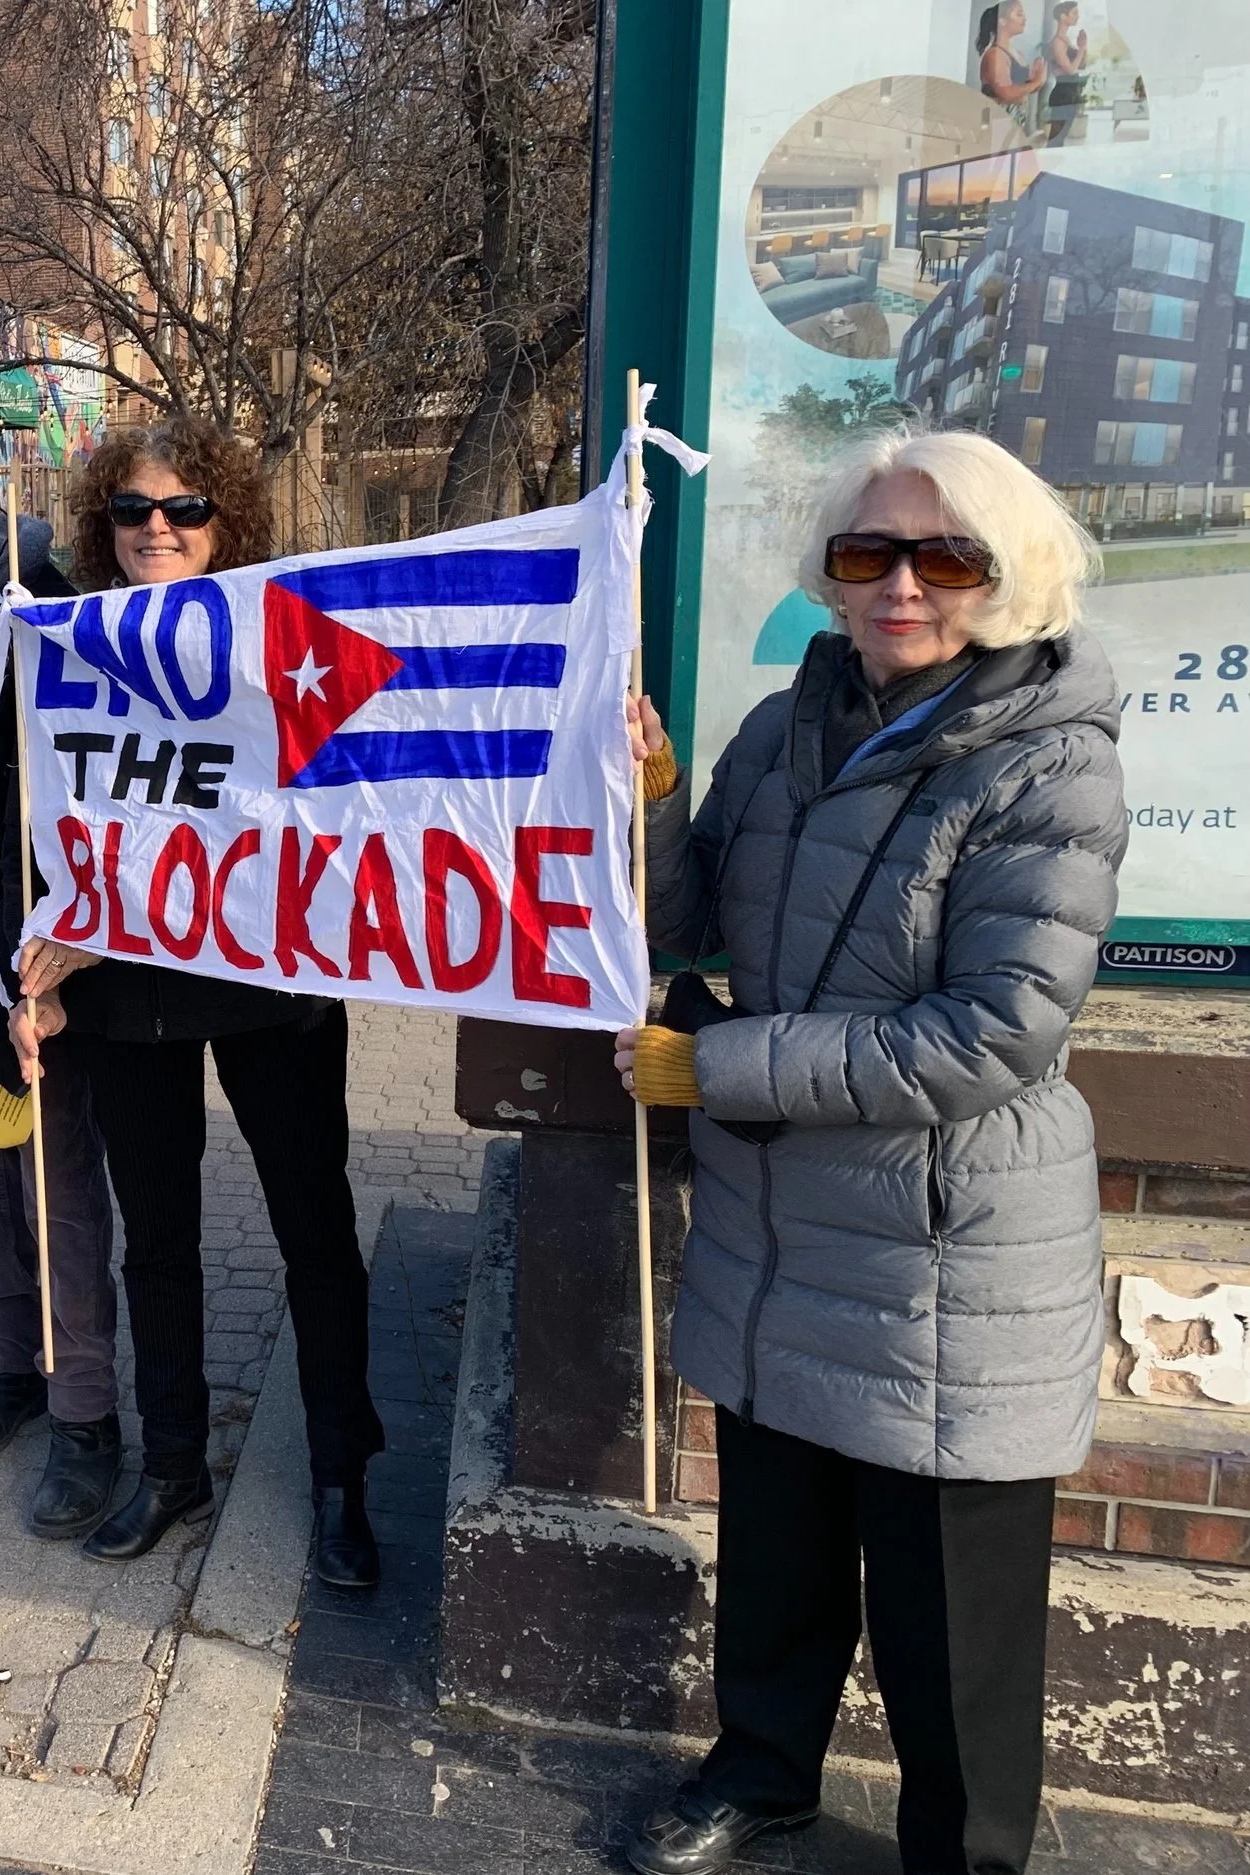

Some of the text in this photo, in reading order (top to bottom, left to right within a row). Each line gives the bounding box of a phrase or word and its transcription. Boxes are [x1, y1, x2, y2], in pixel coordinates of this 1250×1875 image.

[1173, 644, 1249, 681] 28
[53, 732, 235, 810] THE
[1202, 806, 1237, 829] at
[52, 817, 593, 1010] BLOCKADE
[1113, 945, 1226, 966] PATTISON
